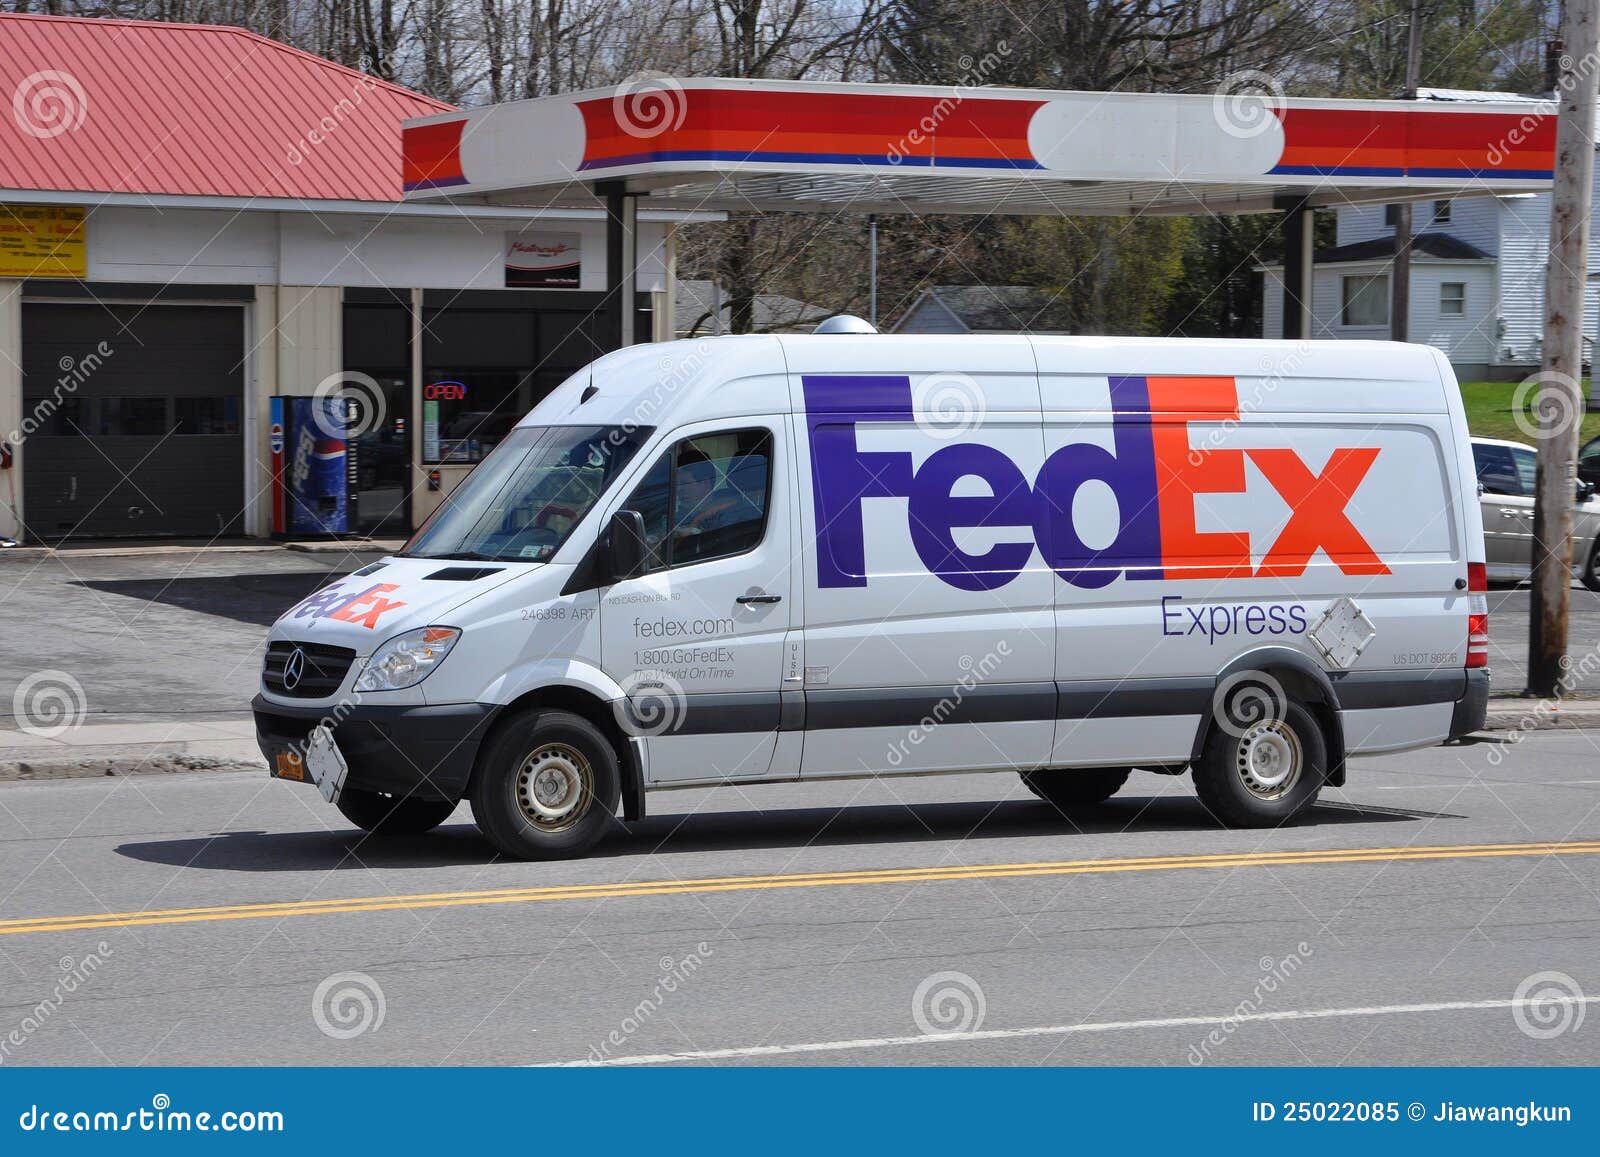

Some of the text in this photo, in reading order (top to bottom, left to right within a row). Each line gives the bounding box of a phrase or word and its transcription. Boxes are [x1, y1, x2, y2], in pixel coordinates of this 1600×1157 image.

[424, 385, 464, 400] OPEN
[801, 376, 1393, 592] FedEx
[655, 592, 681, 602] BORD
[521, 608, 597, 621] 246398 ART
[1162, 596, 1308, 644] Express
[633, 616, 735, 638] fedex.com
[633, 647, 736, 665] 1.800.GoFedEx
[1393, 653, 1407, 664] US
[1409, 653, 1429, 664] DOT
[633, 667, 735, 681] The World On Time
